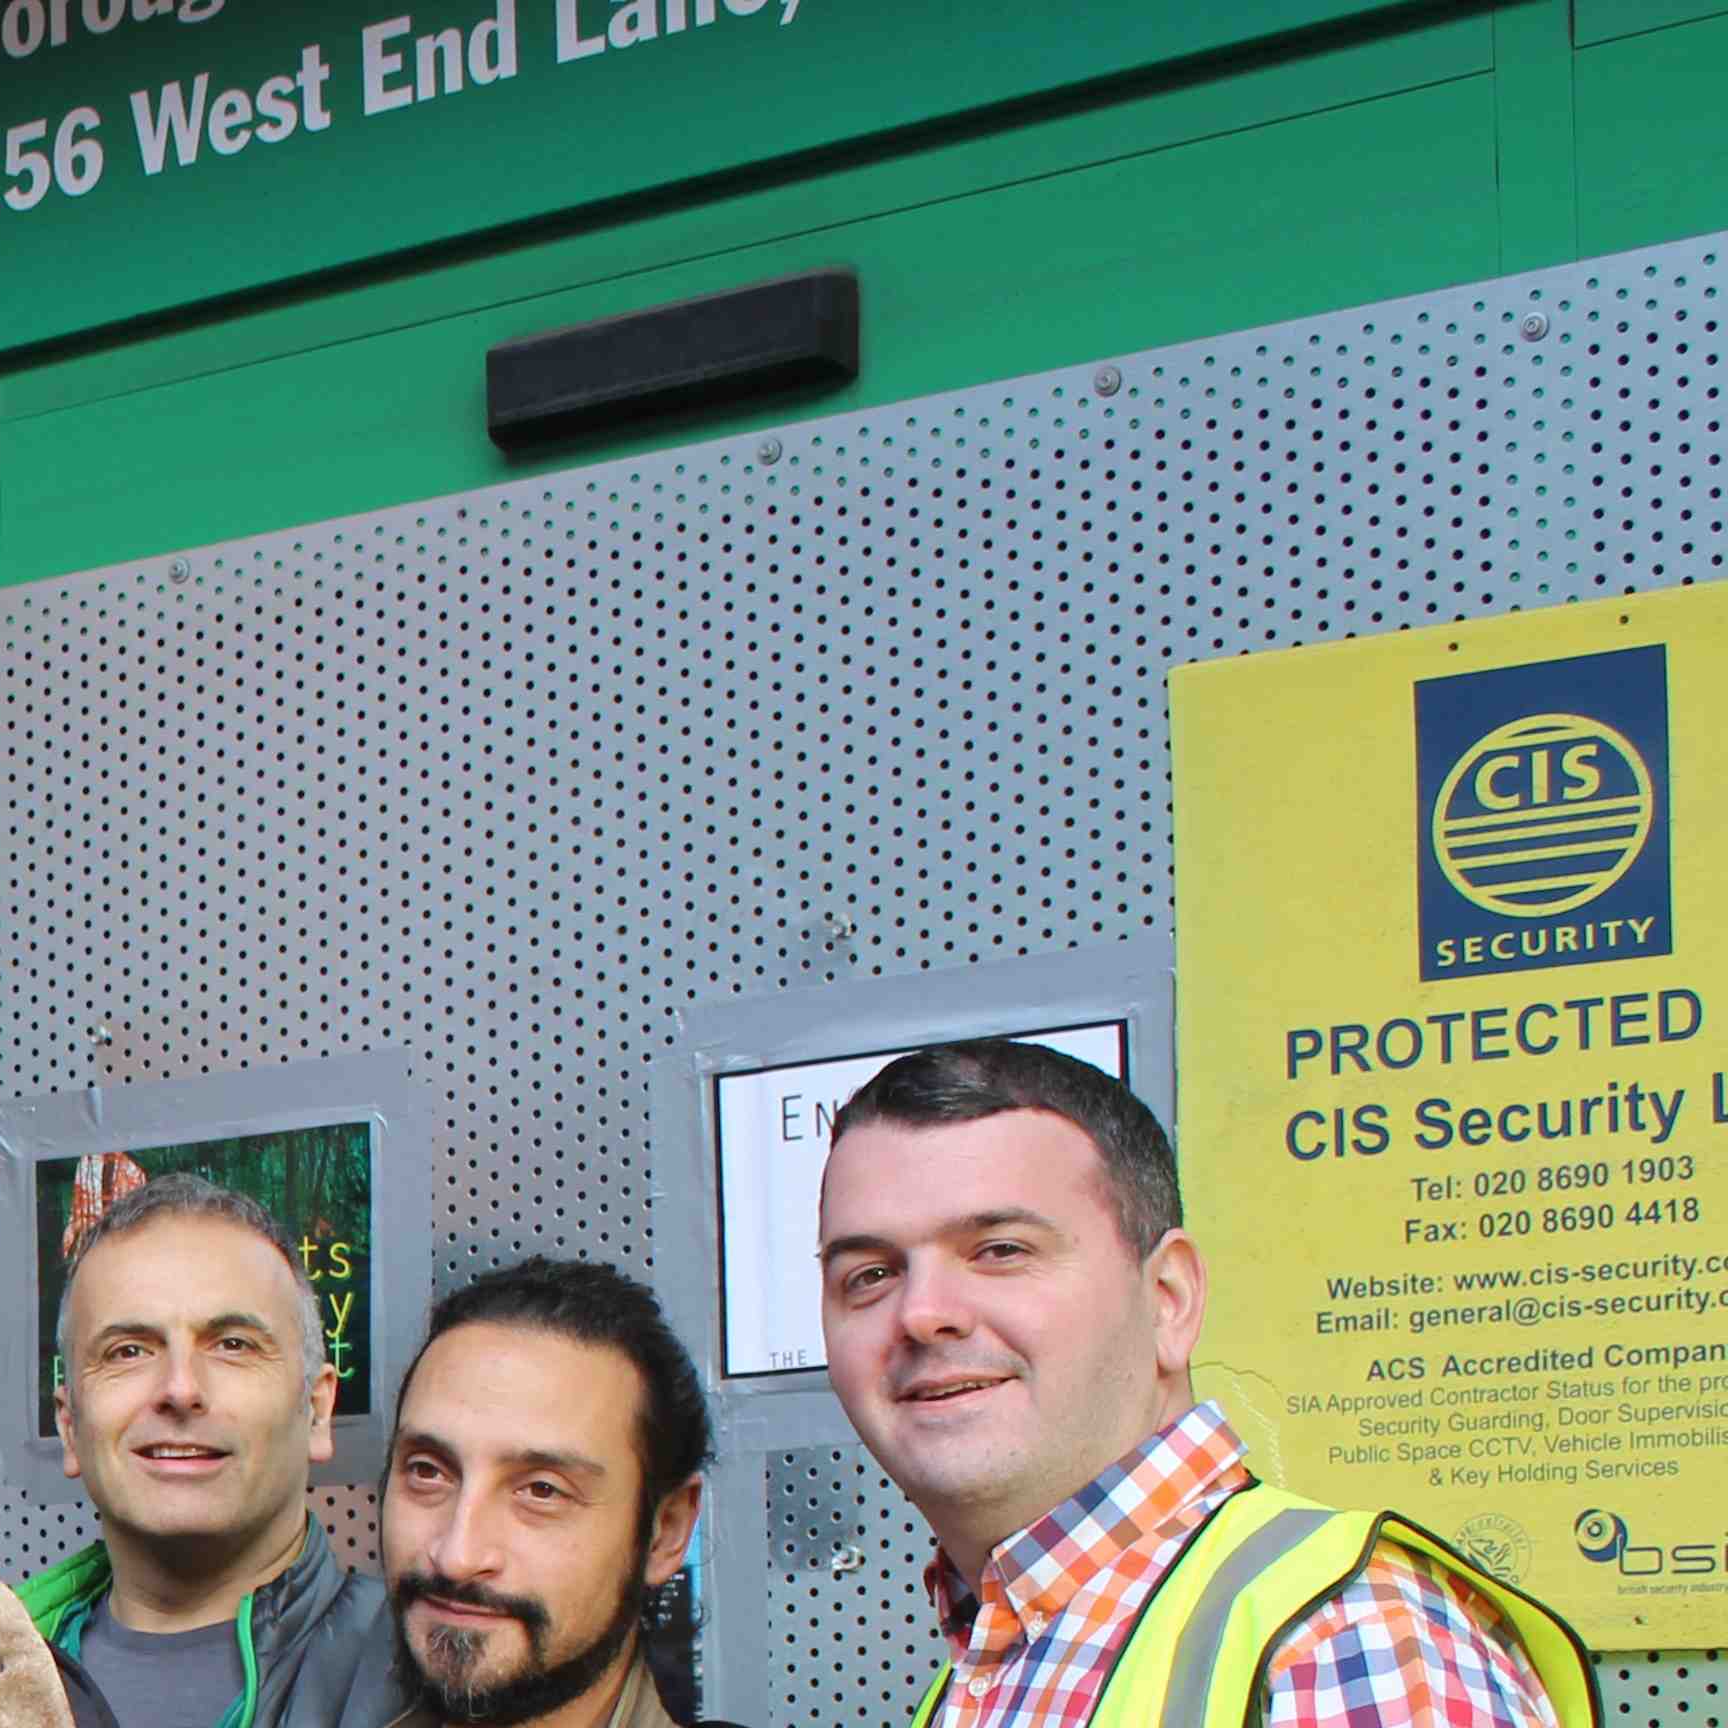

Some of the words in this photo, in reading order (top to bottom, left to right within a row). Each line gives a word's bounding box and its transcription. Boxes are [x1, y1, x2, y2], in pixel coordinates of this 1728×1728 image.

[130, 44, 331, 176] West
[362, 0, 518, 117] End
[1474, 744, 1602, 811] CIS
[1436, 916, 1656, 967] SECURITY
[1286, 988, 1704, 1080] PROTECTED
[1285, 1103, 1392, 1161] CIS
[1414, 1082, 1686, 1150] Security
[1410, 1175, 1462, 1201] Tel:
[1474, 1169, 1526, 1197] 020
[1537, 1162, 1609, 1191] 8690
[1622, 1155, 1694, 1184] 1903
[1405, 1219, 1467, 1244] Fax:
[1479, 1210, 1531, 1238] 020
[1542, 1203, 1614, 1233] 8690
[1625, 1196, 1699, 1226] 4418
[1327, 1273, 1443, 1300] Website:
[1316, 1307, 1399, 1335] Email:
[769, 1349, 808, 1369] THE
[1366, 1356, 1426, 1382] ACS
[1441, 1346, 1594, 1377] Accredited
[1286, 1395, 1323, 1415] SIA
[1326, 1390, 1423, 1416] Approved
[1430, 1384, 1540, 1408] Contractor
[1546, 1379, 1616, 1401] Status
[1622, 1375, 1652, 1395] for
[1658, 1374, 1692, 1393] the
[1359, 1414, 1441, 1438] Security
[1448, 1409, 1550, 1433] Guarding,
[1558, 1406, 1612, 1426] Door
[1328, 1444, 1391, 1465] Public
[1397, 1442, 1461, 1464] Space
[1544, 1432, 1622, 1454] Vehicle
[1429, 1468, 1444, 1487] &
[1450, 1467, 1490, 1489] Key
[1497, 1462, 1577, 1485] Holding
[1585, 1460, 1679, 1480] Services
